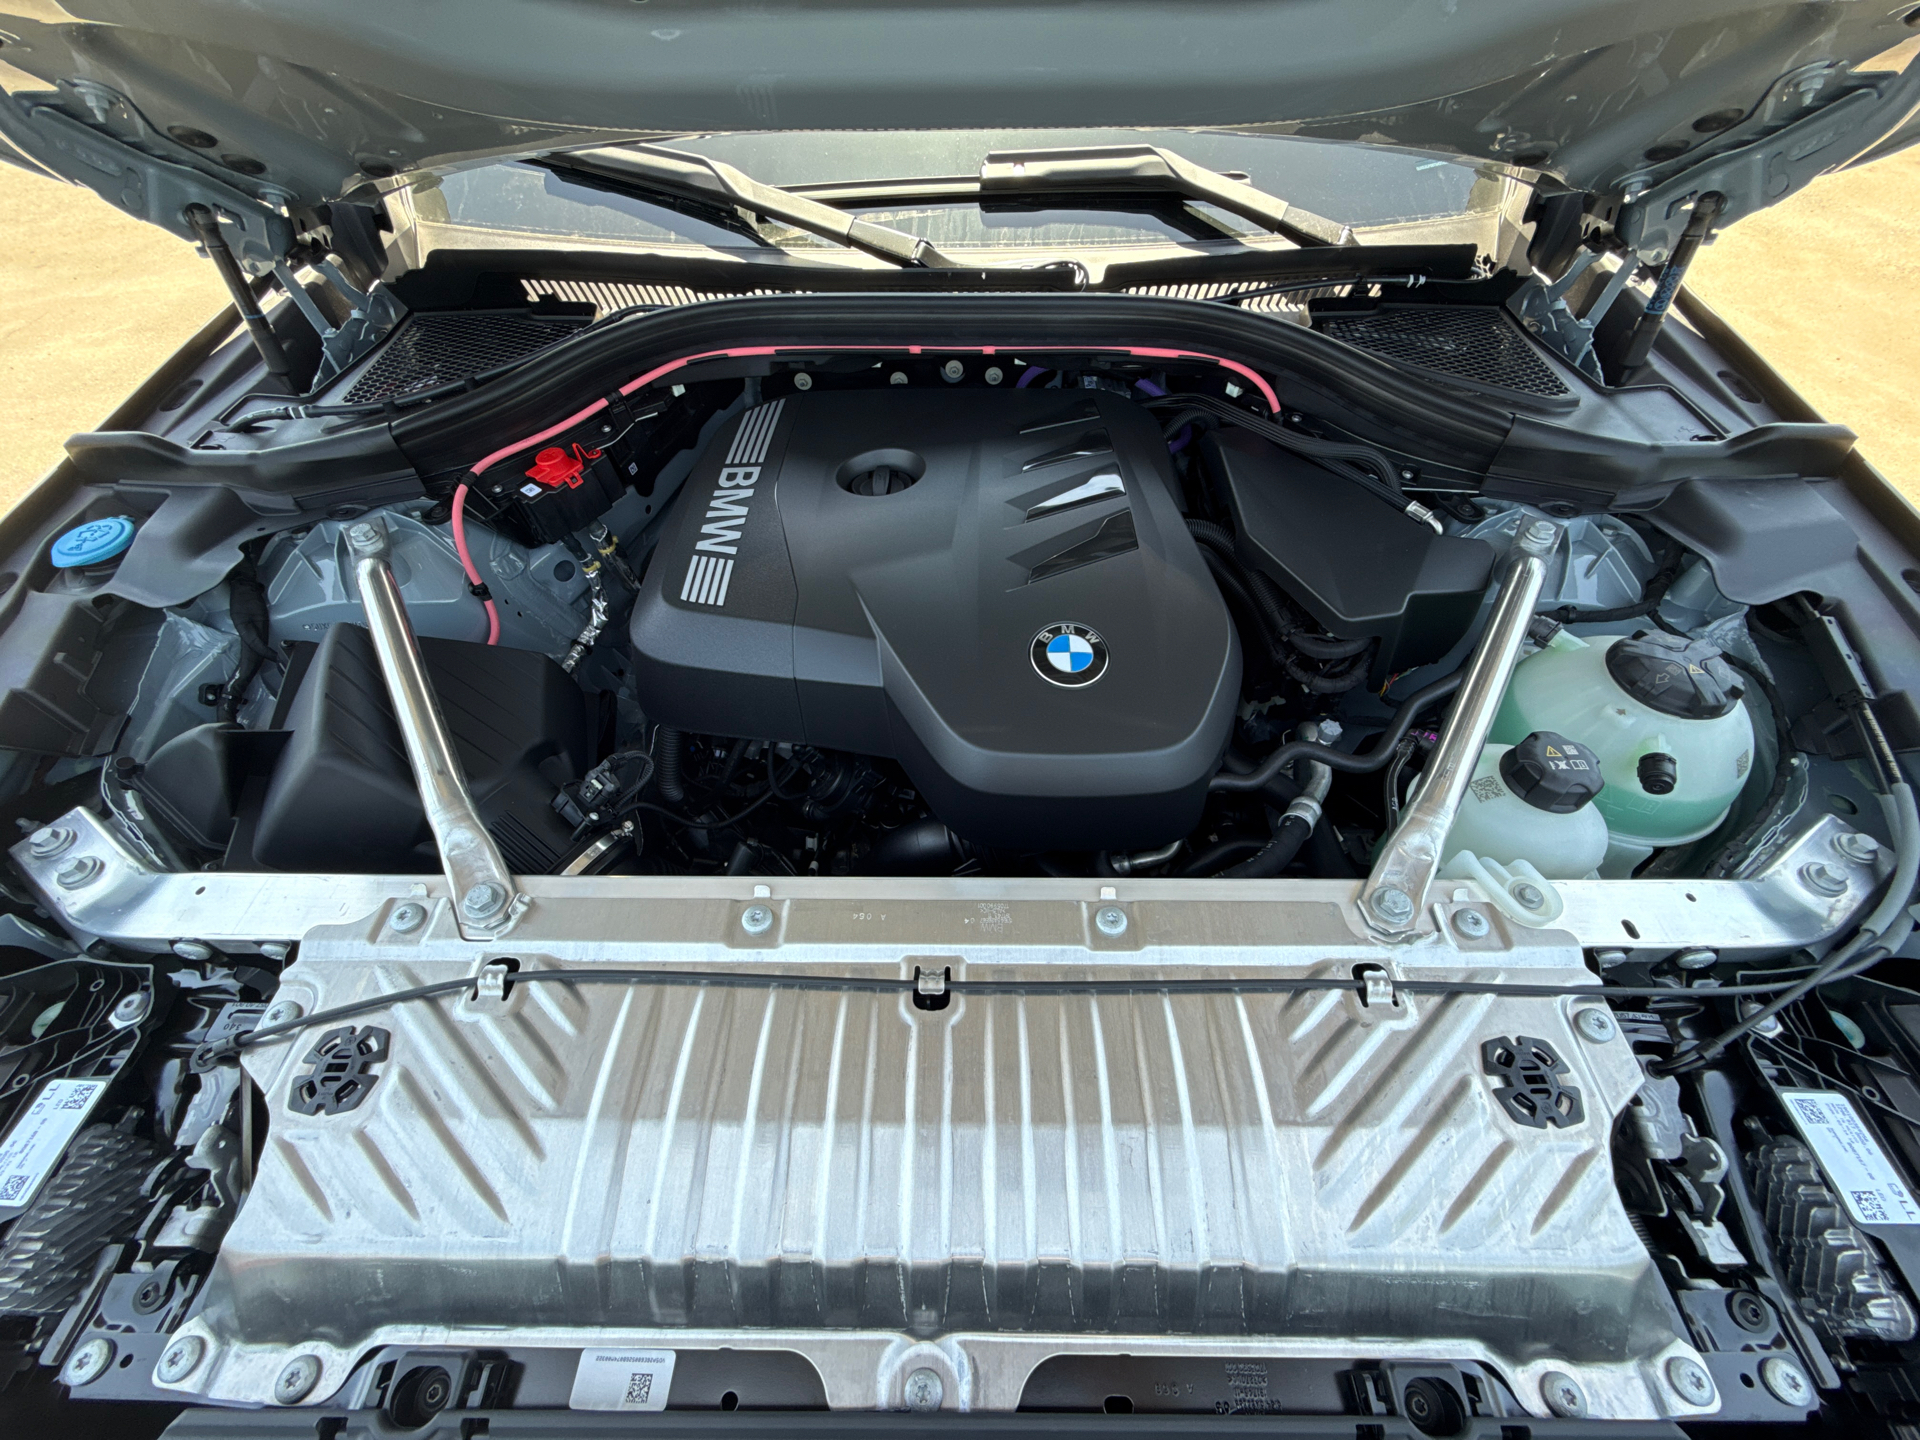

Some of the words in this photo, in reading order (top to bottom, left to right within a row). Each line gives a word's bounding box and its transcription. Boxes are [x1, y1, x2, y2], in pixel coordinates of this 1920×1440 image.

[695, 466, 762, 555] BMW
[1039, 625, 1100, 643] BMW
[1898, 1200, 1916, 1221] LL
